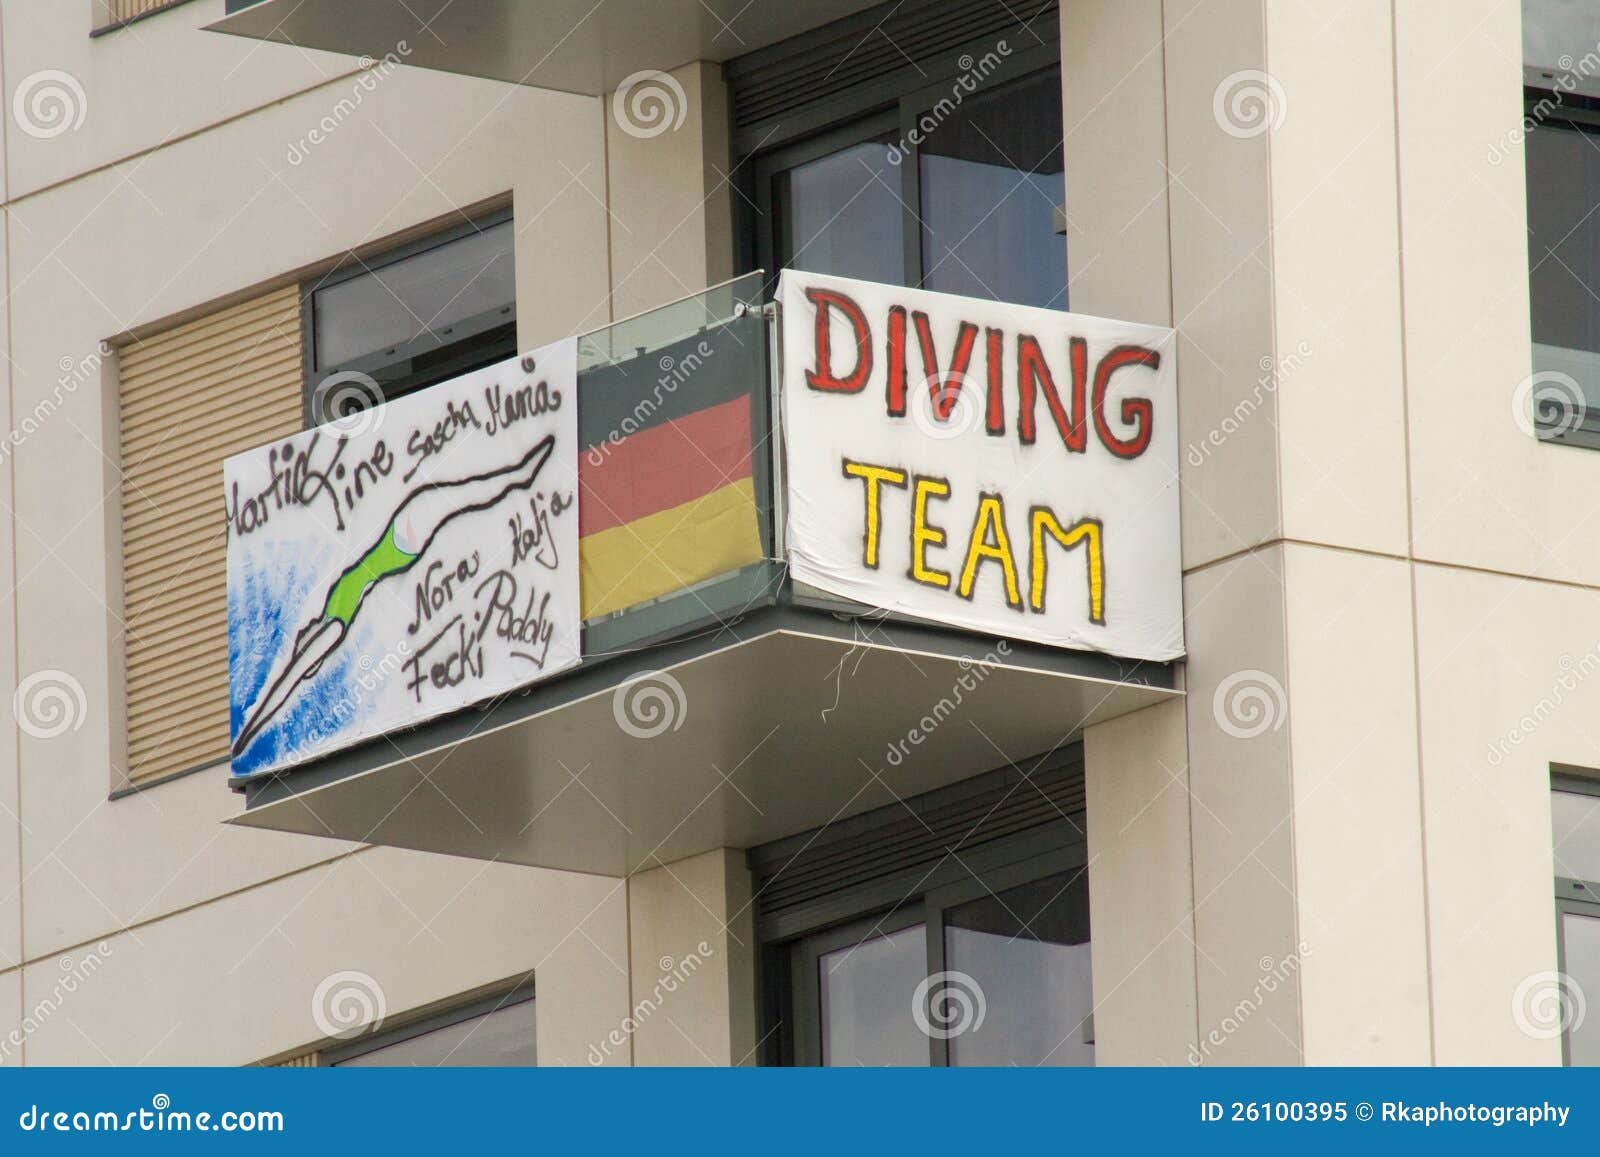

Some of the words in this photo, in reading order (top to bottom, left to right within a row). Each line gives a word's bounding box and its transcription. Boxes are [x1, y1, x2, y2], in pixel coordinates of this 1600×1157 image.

[805, 286, 1160, 459] DIVING
[408, 549, 480, 635] Nora
[508, 490, 573, 570] Katja
[842, 458, 1105, 626] TEAM
[401, 611, 484, 703] Fecki
[473, 569, 554, 670] Paddy
